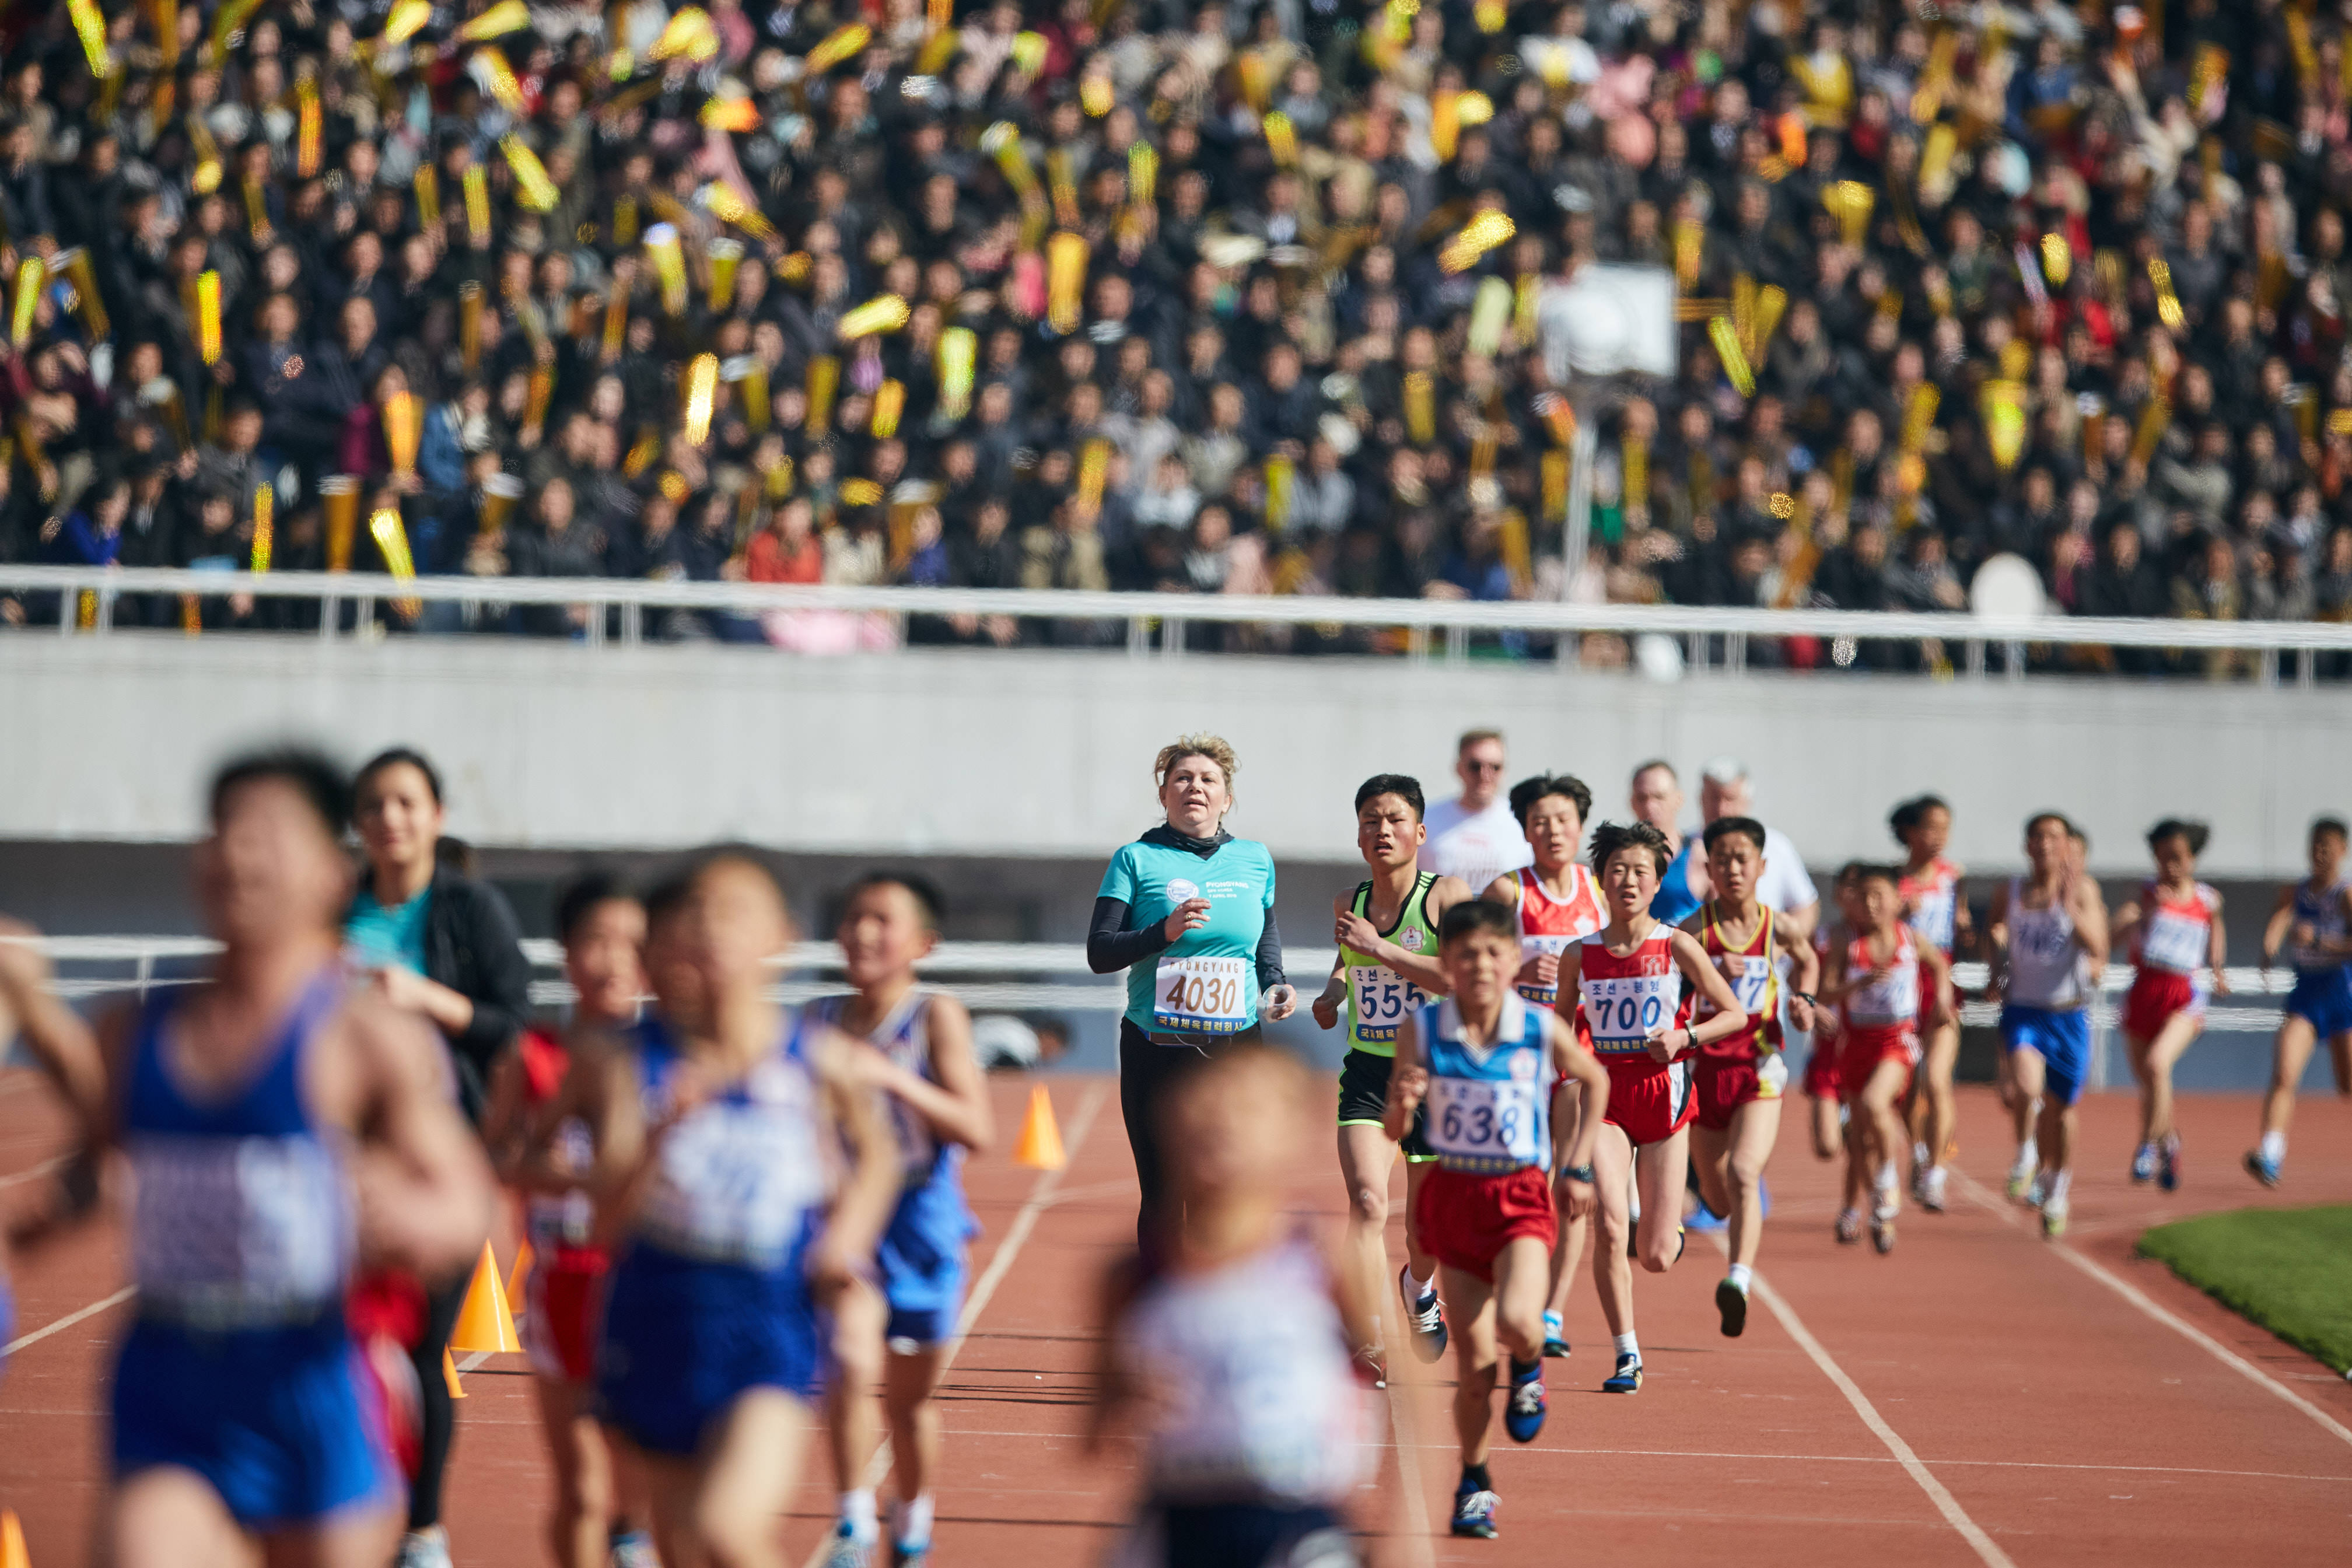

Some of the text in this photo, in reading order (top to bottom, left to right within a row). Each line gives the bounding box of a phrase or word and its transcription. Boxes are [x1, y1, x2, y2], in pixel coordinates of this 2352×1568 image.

[1170, 961, 1238, 974] PYONGYANG
[1167, 975, 1236, 1014] 4030
[1361, 982, 1425, 1019] 555
[1595, 996, 1661, 1030] 700
[1443, 1103, 1518, 1147] 638
